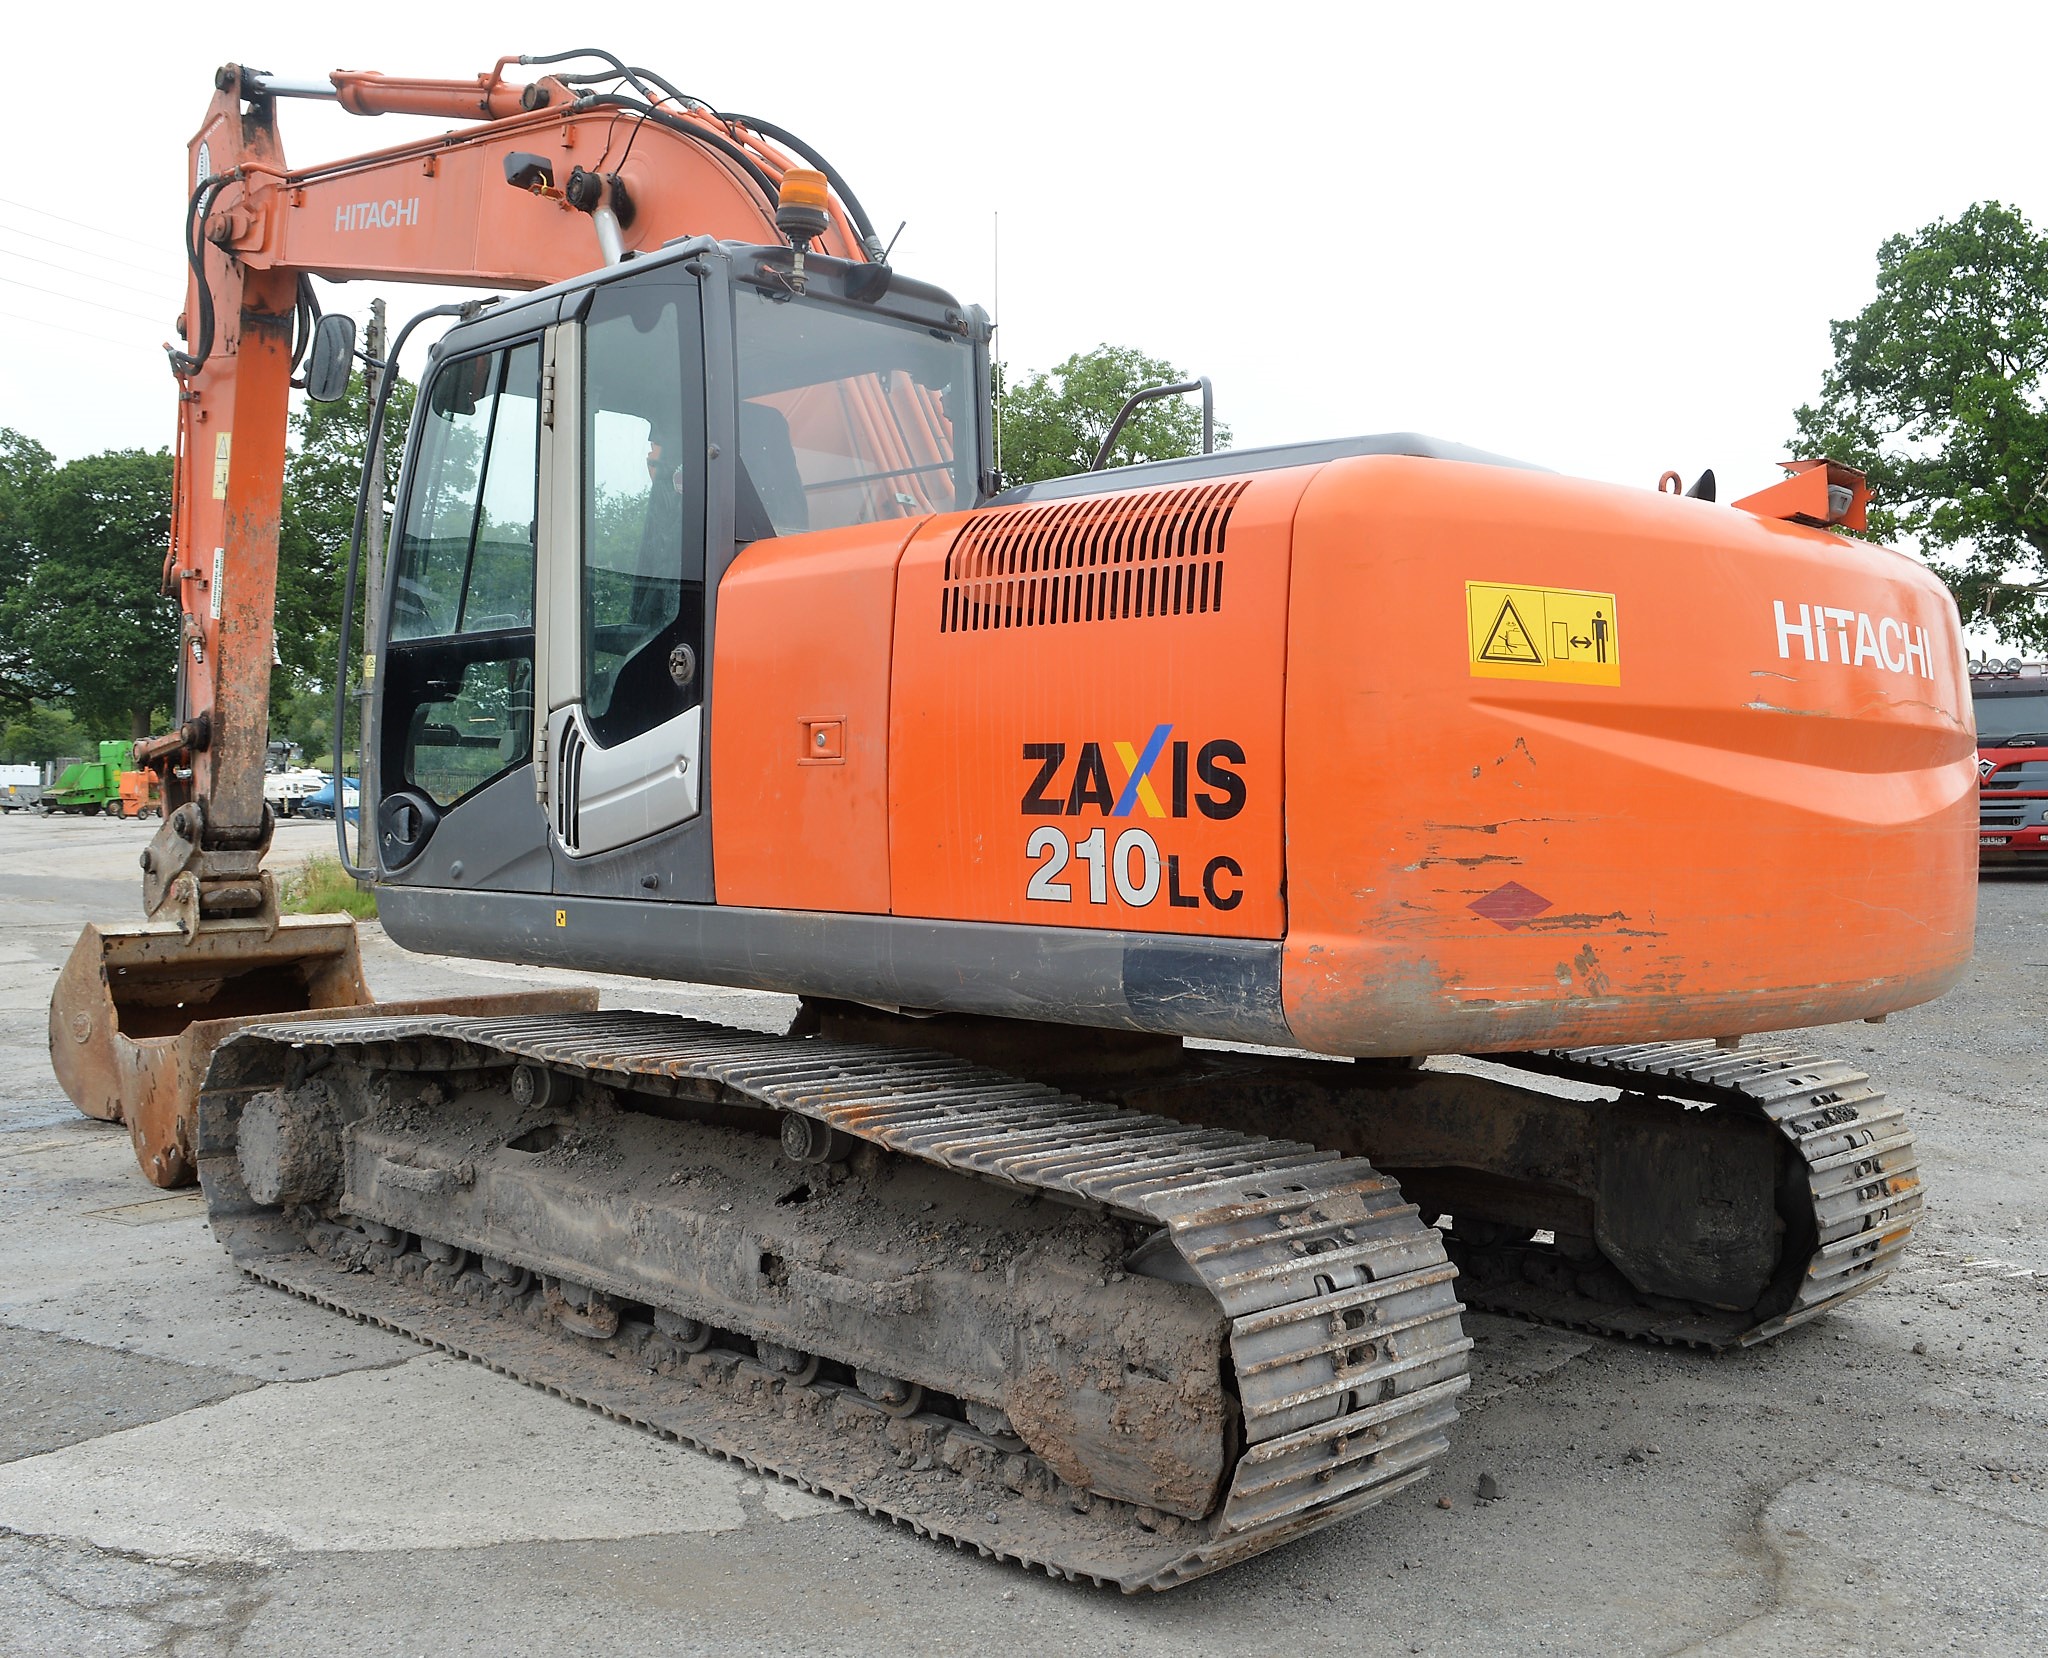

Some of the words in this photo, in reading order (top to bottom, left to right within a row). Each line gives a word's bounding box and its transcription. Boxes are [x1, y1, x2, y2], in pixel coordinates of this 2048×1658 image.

[335, 197, 419, 232] HITACHI
[1773, 600, 1934, 681] HITACHI
[1021, 724, 1247, 820] ZAXIS
